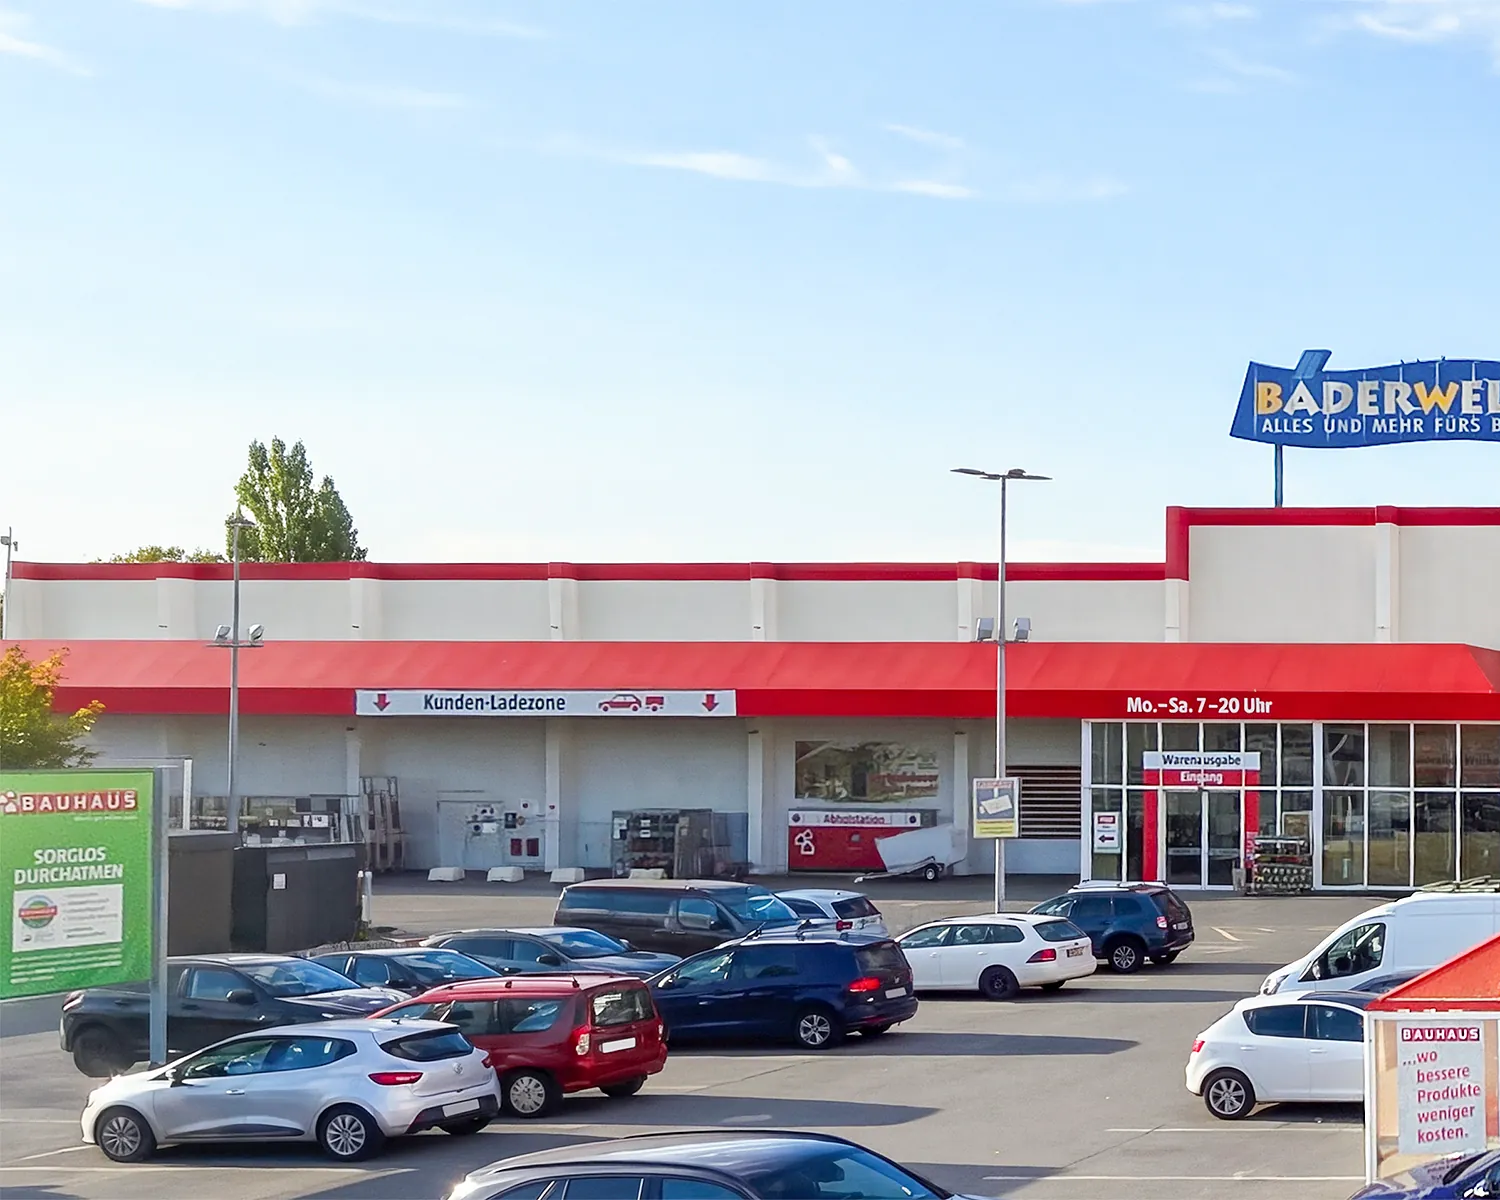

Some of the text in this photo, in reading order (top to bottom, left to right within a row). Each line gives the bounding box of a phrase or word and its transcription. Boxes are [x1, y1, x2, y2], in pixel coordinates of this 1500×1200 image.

[1262, 417, 1313, 434] ALLES
[1324, 417, 1362, 434] UND
[1372, 417, 1424, 434] MEHR
[1434, 415, 1481, 434] FÜRS
[423, 693, 566, 711] Kunden-Ladezone
[1243, 697, 1273, 714] Uhr
[1162, 755, 1242, 767] Warenausgabe
[1180, 771, 1224, 784] Eingang
[21, 790, 137, 811] BAUHAUS
[33, 848, 107, 865] SORGLOS
[14, 864, 124, 885] DURCHATMEN
[1402, 1028, 1480, 1041] BAUHAUS
[1416, 1065, 1471, 1084] bessere
[1417, 1083, 1482, 1104] Produkte
[1417, 1103, 1477, 1124] weniger
[1417, 1127, 1469, 1145] kosten.
